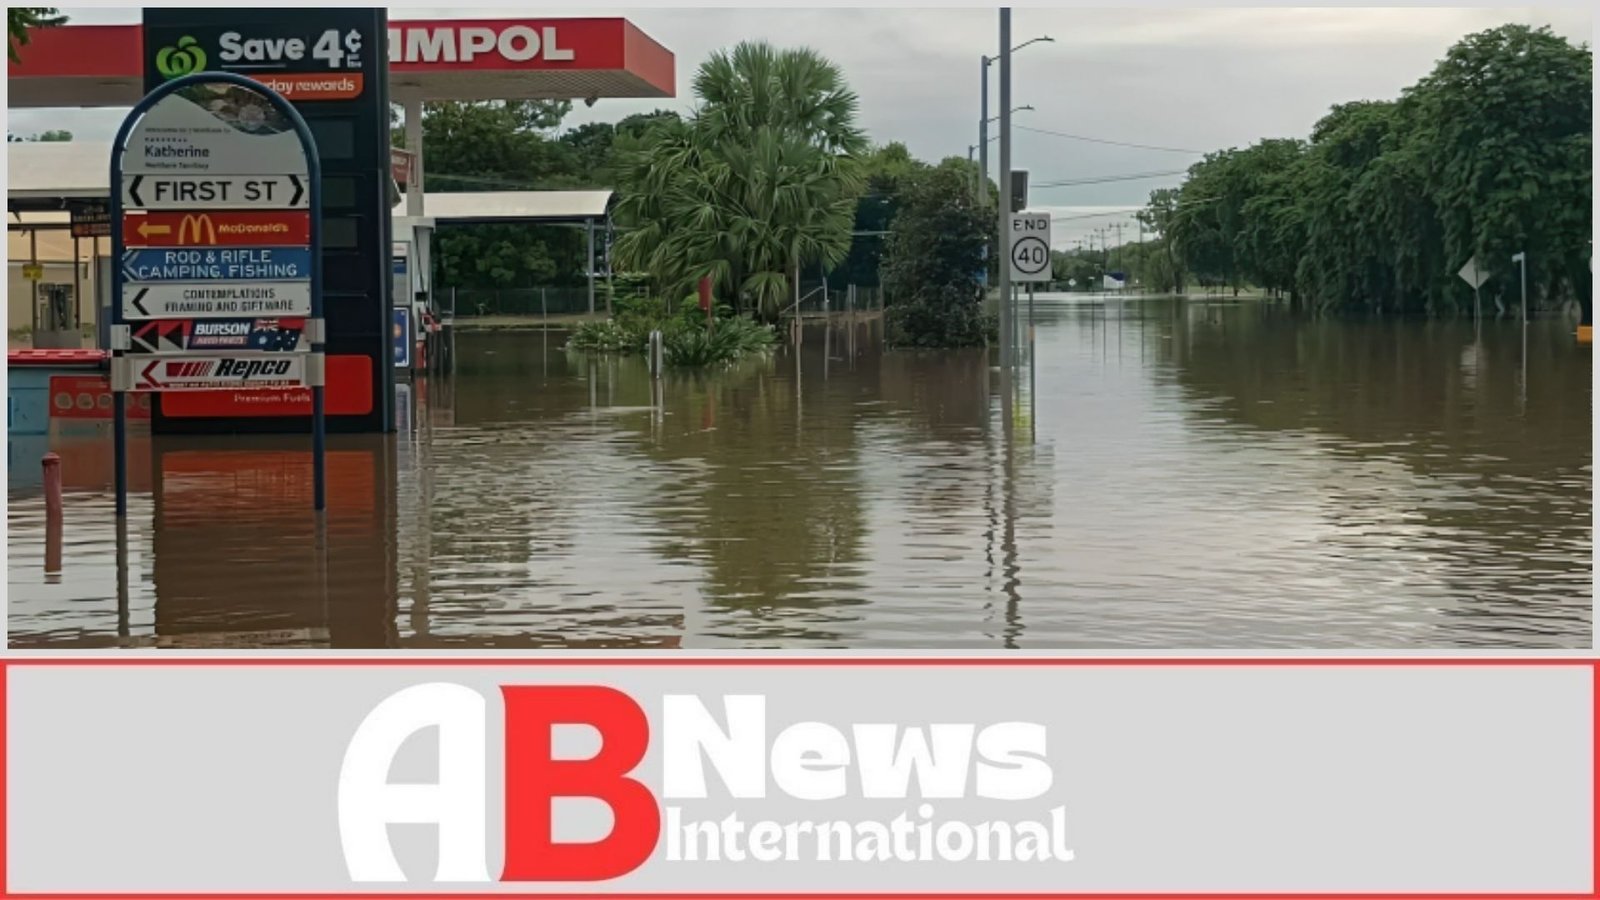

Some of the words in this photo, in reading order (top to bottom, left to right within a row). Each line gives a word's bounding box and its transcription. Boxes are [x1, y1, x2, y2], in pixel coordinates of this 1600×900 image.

[219, 31, 305, 61] Save
[296, 79, 355, 91] rewards
[144, 145, 210, 157] Katherine
[155, 181, 231, 201] FIRST
[244, 181, 277, 201] ST
[218, 223, 289, 234] McDonald's
[1013, 219, 1048, 231] END
[165, 251, 201, 264] ROD
[206, 251, 216, 263] &
[221, 250, 272, 263] RIFLE
[1017, 247, 1044, 265] 40
[228, 264, 297, 277] FISHING
[183, 288, 276, 300] CONTEMPLATIONS
[165, 302, 212, 312] FRAMING
[216, 301, 238, 311] AND
[194, 322, 251, 335] BURSON
[214, 358, 291, 379] Repco
[234, 393, 281, 403] Premium
[284, 393, 311, 402] Fuels
